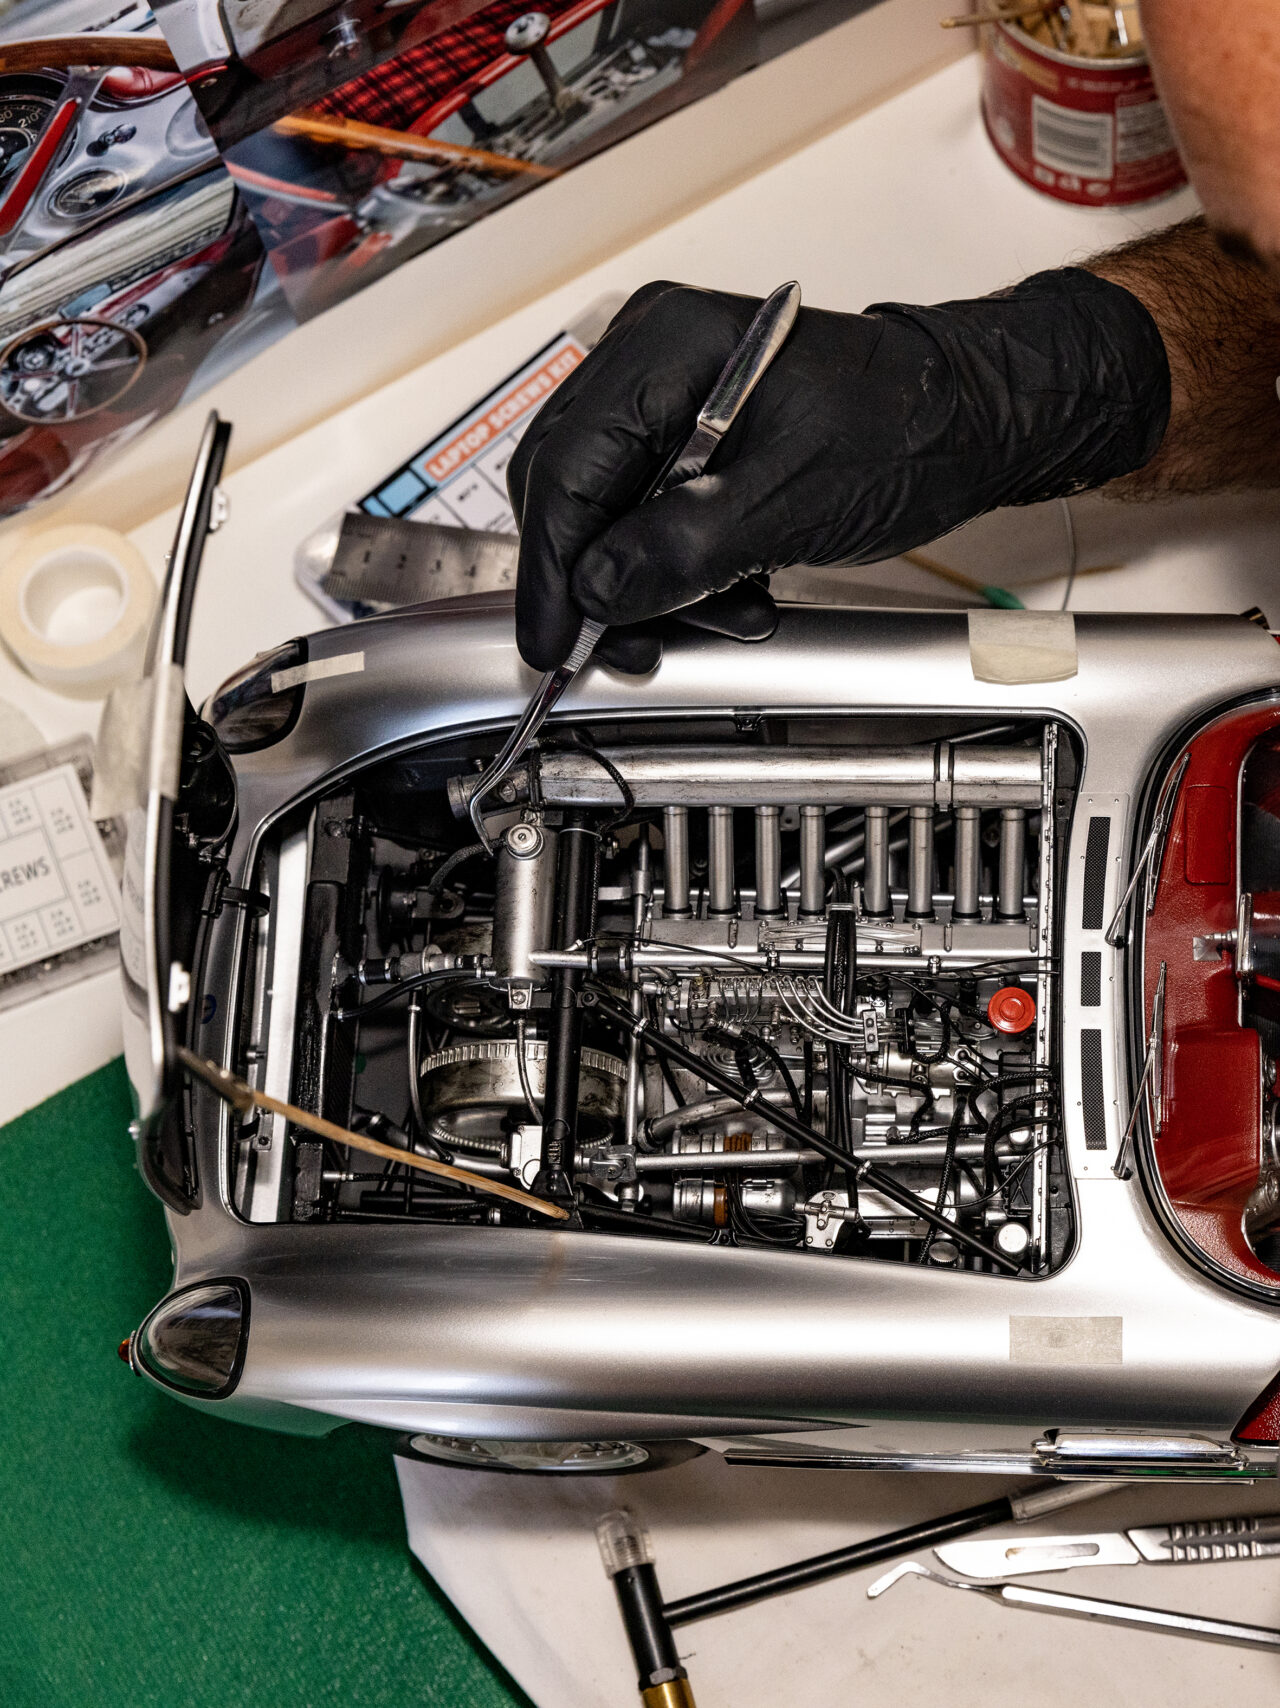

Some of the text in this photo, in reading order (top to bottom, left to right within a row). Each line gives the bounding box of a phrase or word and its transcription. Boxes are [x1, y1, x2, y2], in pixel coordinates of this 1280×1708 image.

[18, 112, 39, 128] 210
[428, 350, 579, 478] LAPTOP SCREWS KIT
[0, 855, 50, 892] REWS
